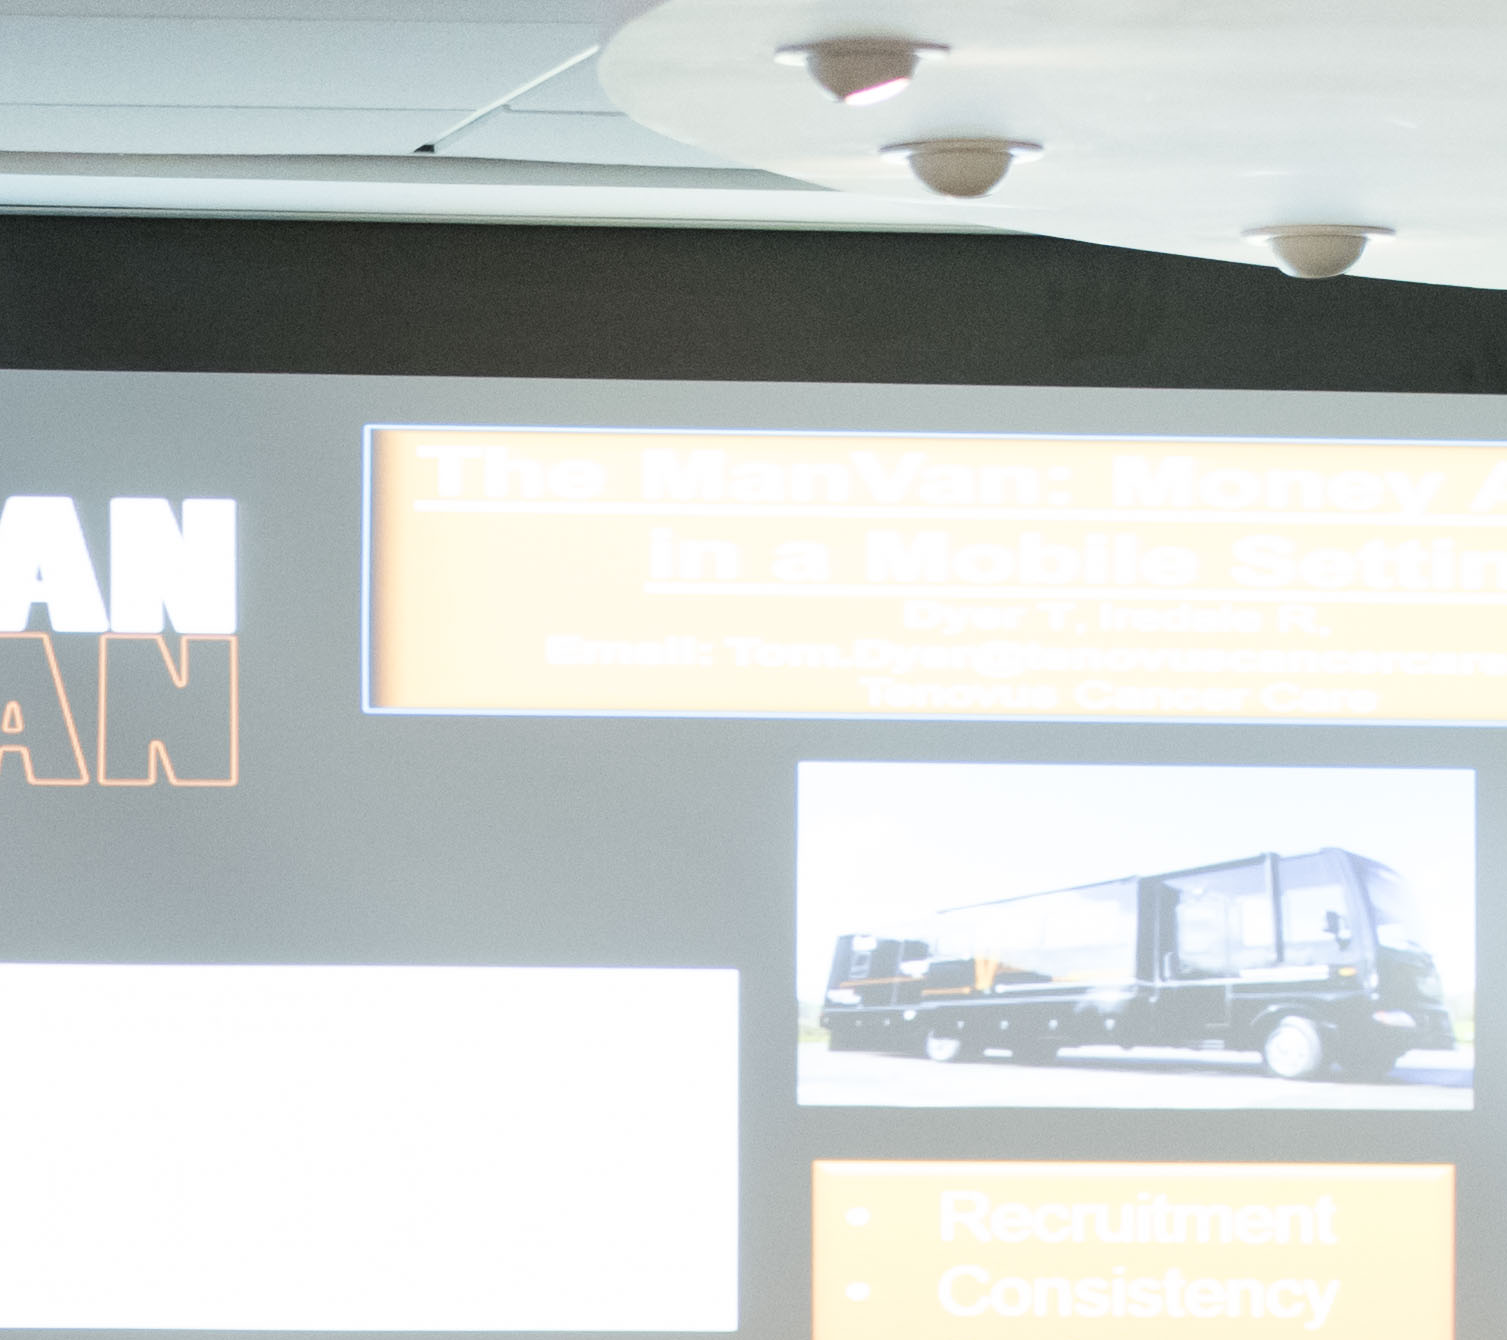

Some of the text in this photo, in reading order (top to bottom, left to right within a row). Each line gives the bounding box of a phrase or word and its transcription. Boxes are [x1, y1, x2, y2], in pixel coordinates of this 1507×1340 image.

[418, 447, 604, 498] The
[644, 450, 1070, 505] ManVan:
[1114, 456, 1443, 518] Money
[651, 529, 740, 579] in
[772, 541, 829, 582] a
[866, 531, 1197, 584] Mobile
[904, 601, 1024, 633] Dyer
[1100, 604, 1261, 632] Iredale
[545, 636, 712, 667] Email:
[861, 679, 1377, 711] Tenovus Cancer Care
[938, 1190, 1338, 1246] Recruitment
[937, 1265, 1342, 1332] Consistency
